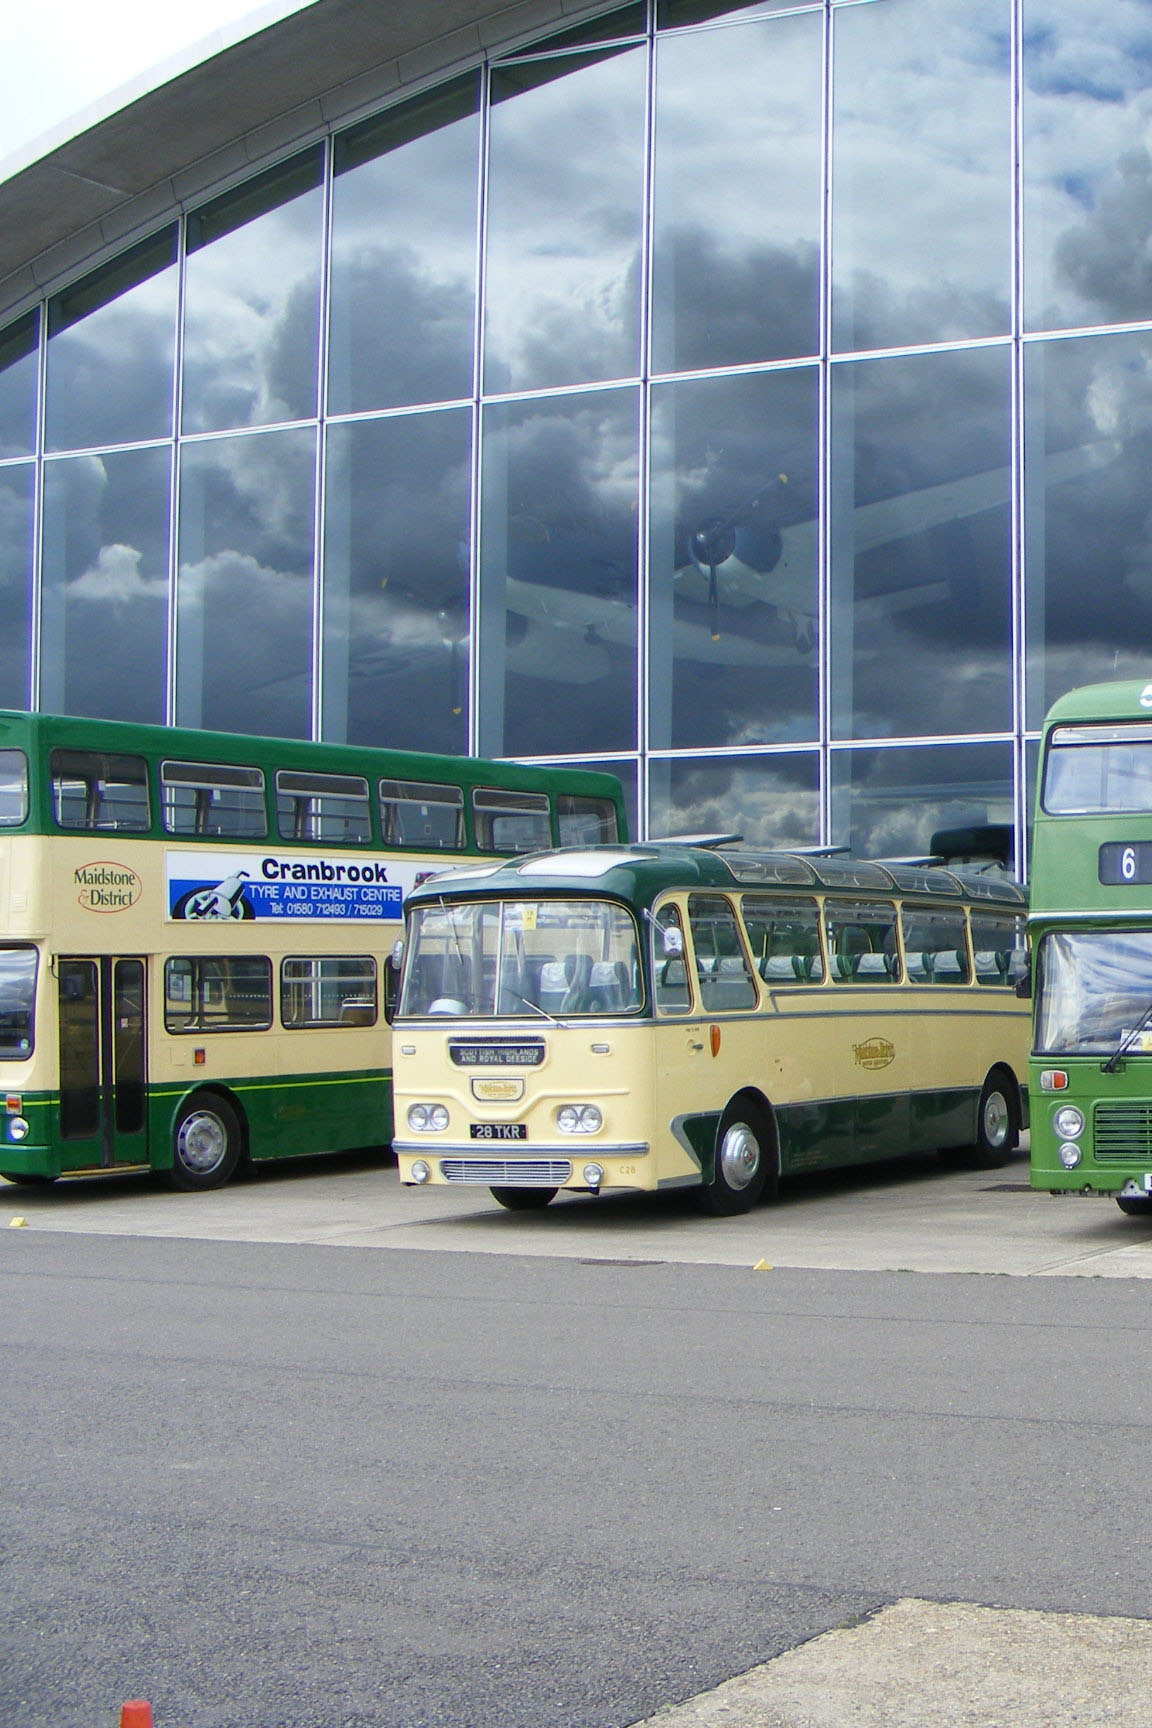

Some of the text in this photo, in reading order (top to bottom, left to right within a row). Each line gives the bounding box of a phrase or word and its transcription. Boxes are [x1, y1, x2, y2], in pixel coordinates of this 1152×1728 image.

[262, 858, 389, 883] Cranbrook
[1121, 848, 1136, 879] 6
[74, 867, 136, 886] Maidstone
[91, 889, 133, 906] District
[250, 885, 401, 902] TYRE AND EXHAUST CENTRE
[287, 902, 314, 915] 01580
[316, 903, 346, 916] 712493
[354, 904, 384, 916] 715029
[460, 1048, 495, 1056] SCOTTISH
[461, 1055, 538, 1063] AND ROYAL DEESIDE
[476, 1125, 521, 1139] 28 TKR
